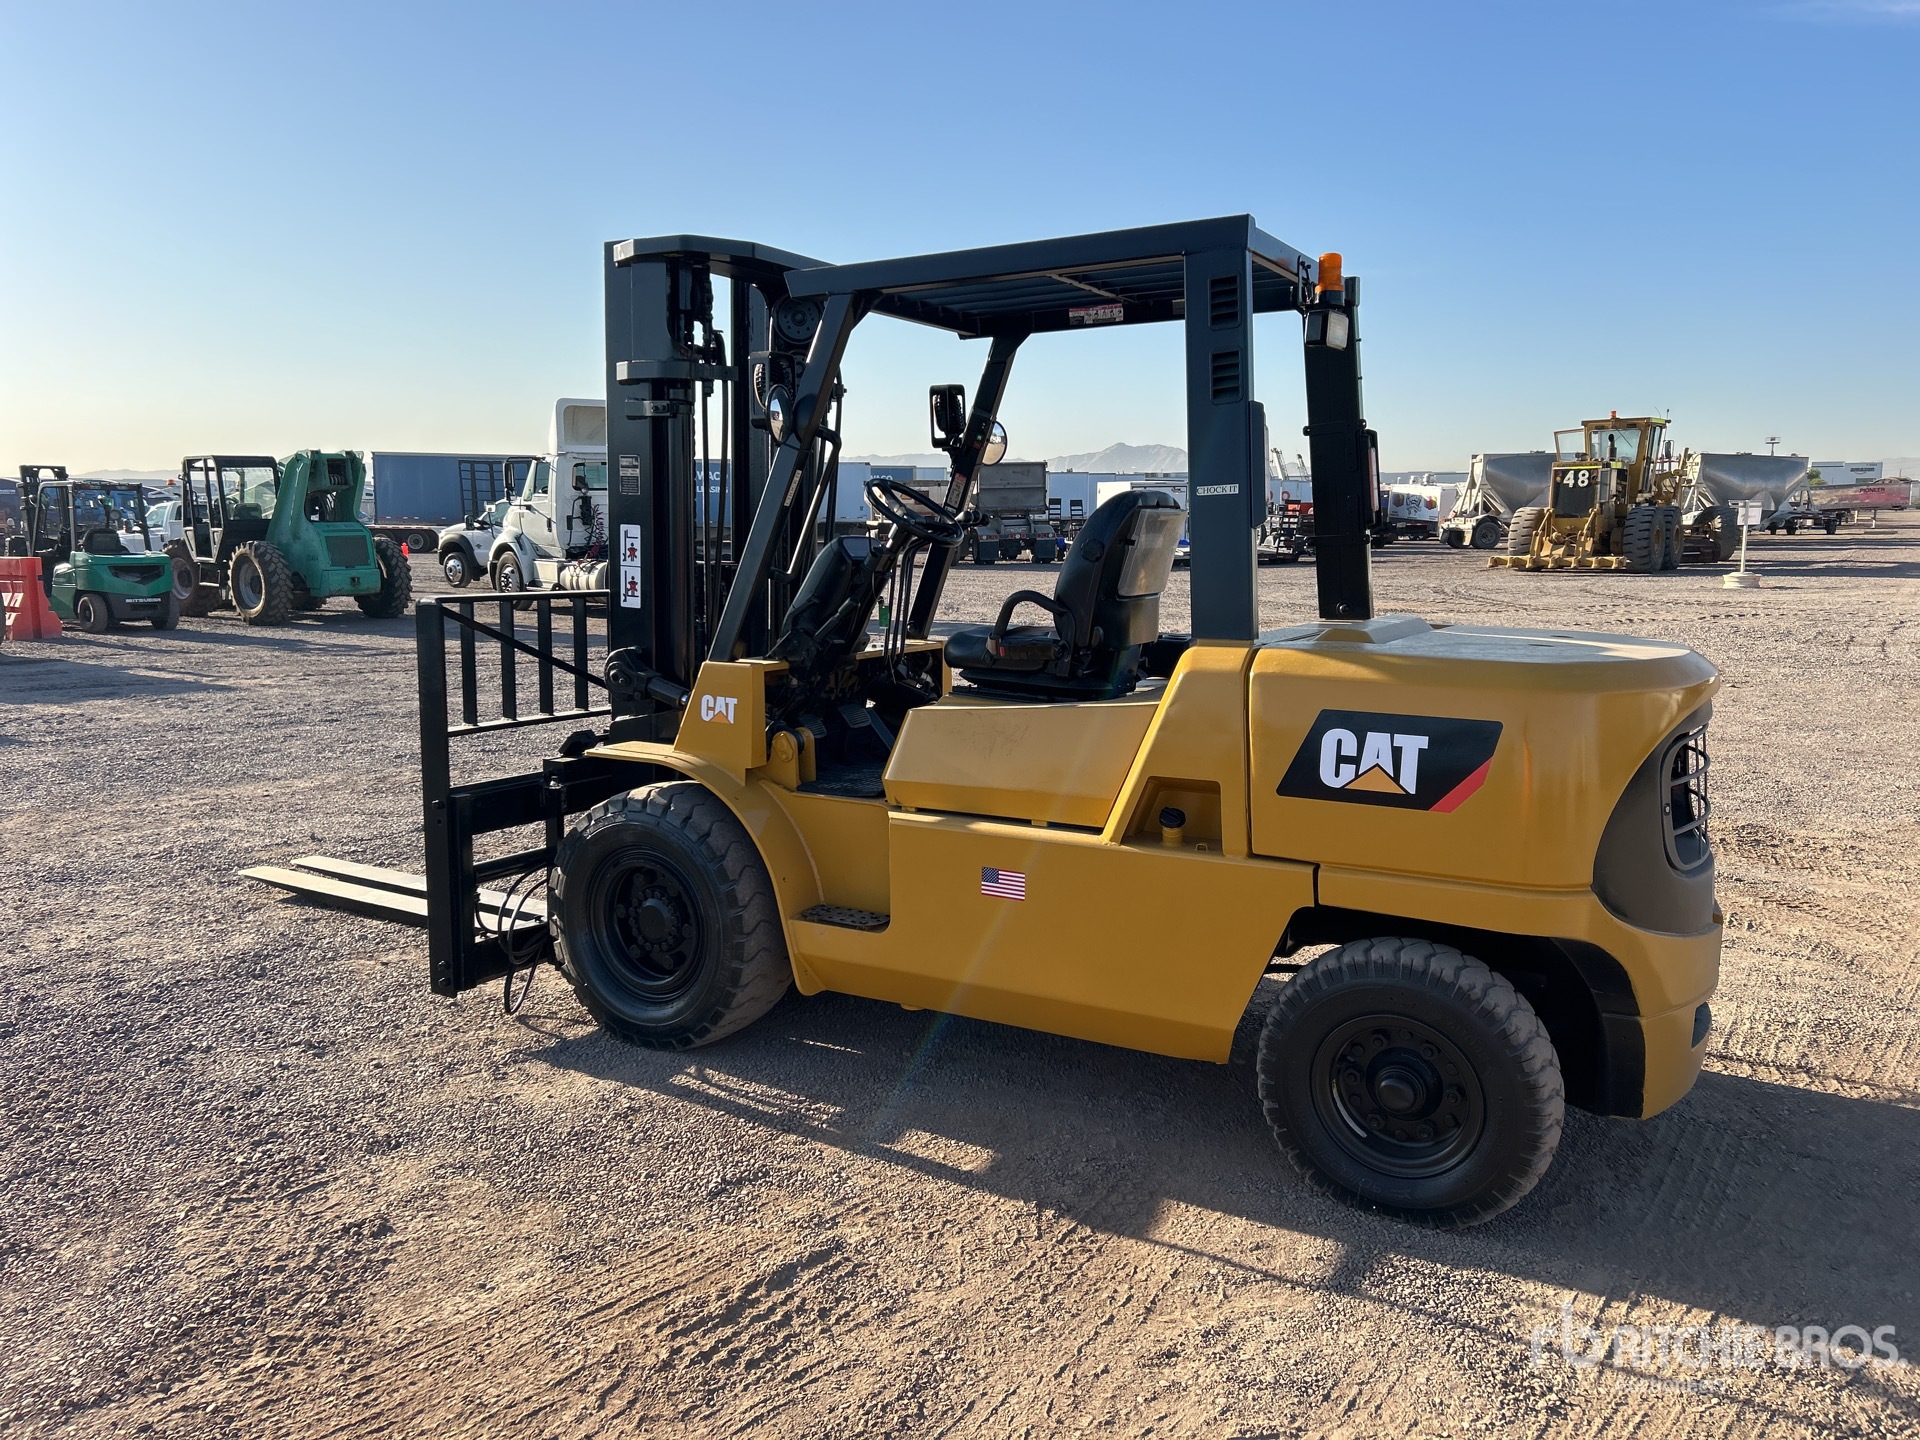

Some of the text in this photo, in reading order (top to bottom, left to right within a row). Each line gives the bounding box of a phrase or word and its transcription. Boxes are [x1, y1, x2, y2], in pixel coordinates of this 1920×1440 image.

[1196, 485, 1238, 495] CHOCK IT
[1563, 470, 1589, 488] 48
[701, 694, 738, 724] CAT
[1319, 728, 1429, 795] CAT
